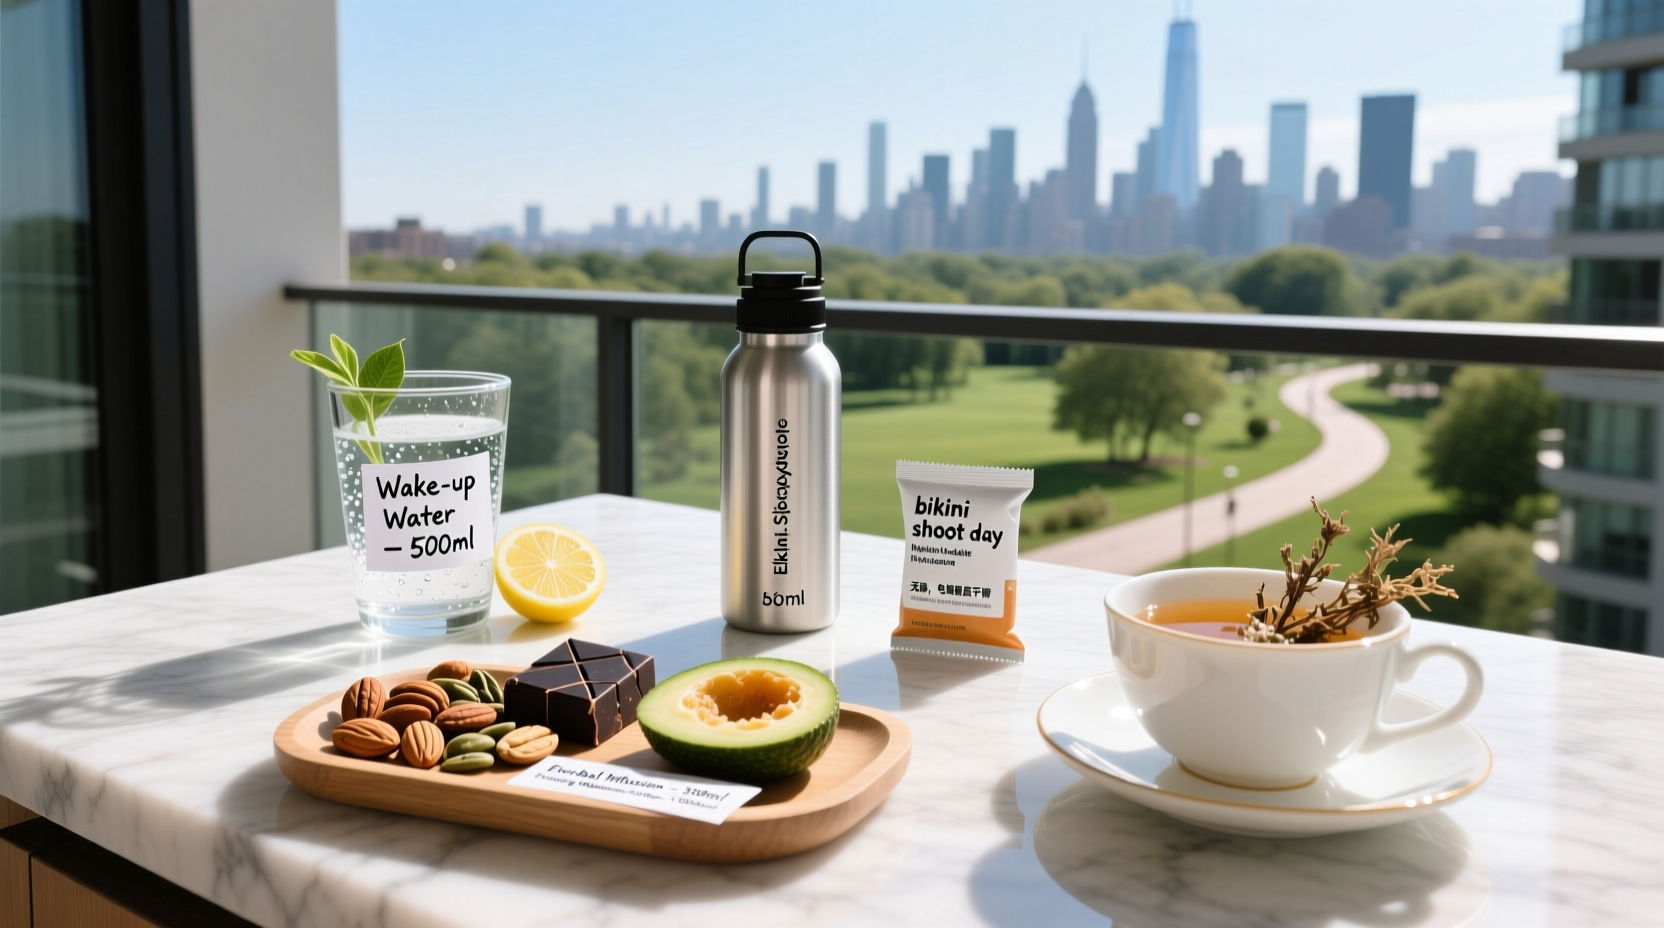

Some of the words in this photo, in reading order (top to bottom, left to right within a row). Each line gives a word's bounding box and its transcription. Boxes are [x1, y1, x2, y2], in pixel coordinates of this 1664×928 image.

[376, 473, 475, 501] Wake-up
[383, 505, 455, 529] Water
[914, 495, 970, 518] bikini
[410, 525, 474, 559] 500ml
[912, 519, 965, 541] shoot
[969, 522, 1004, 550] day
